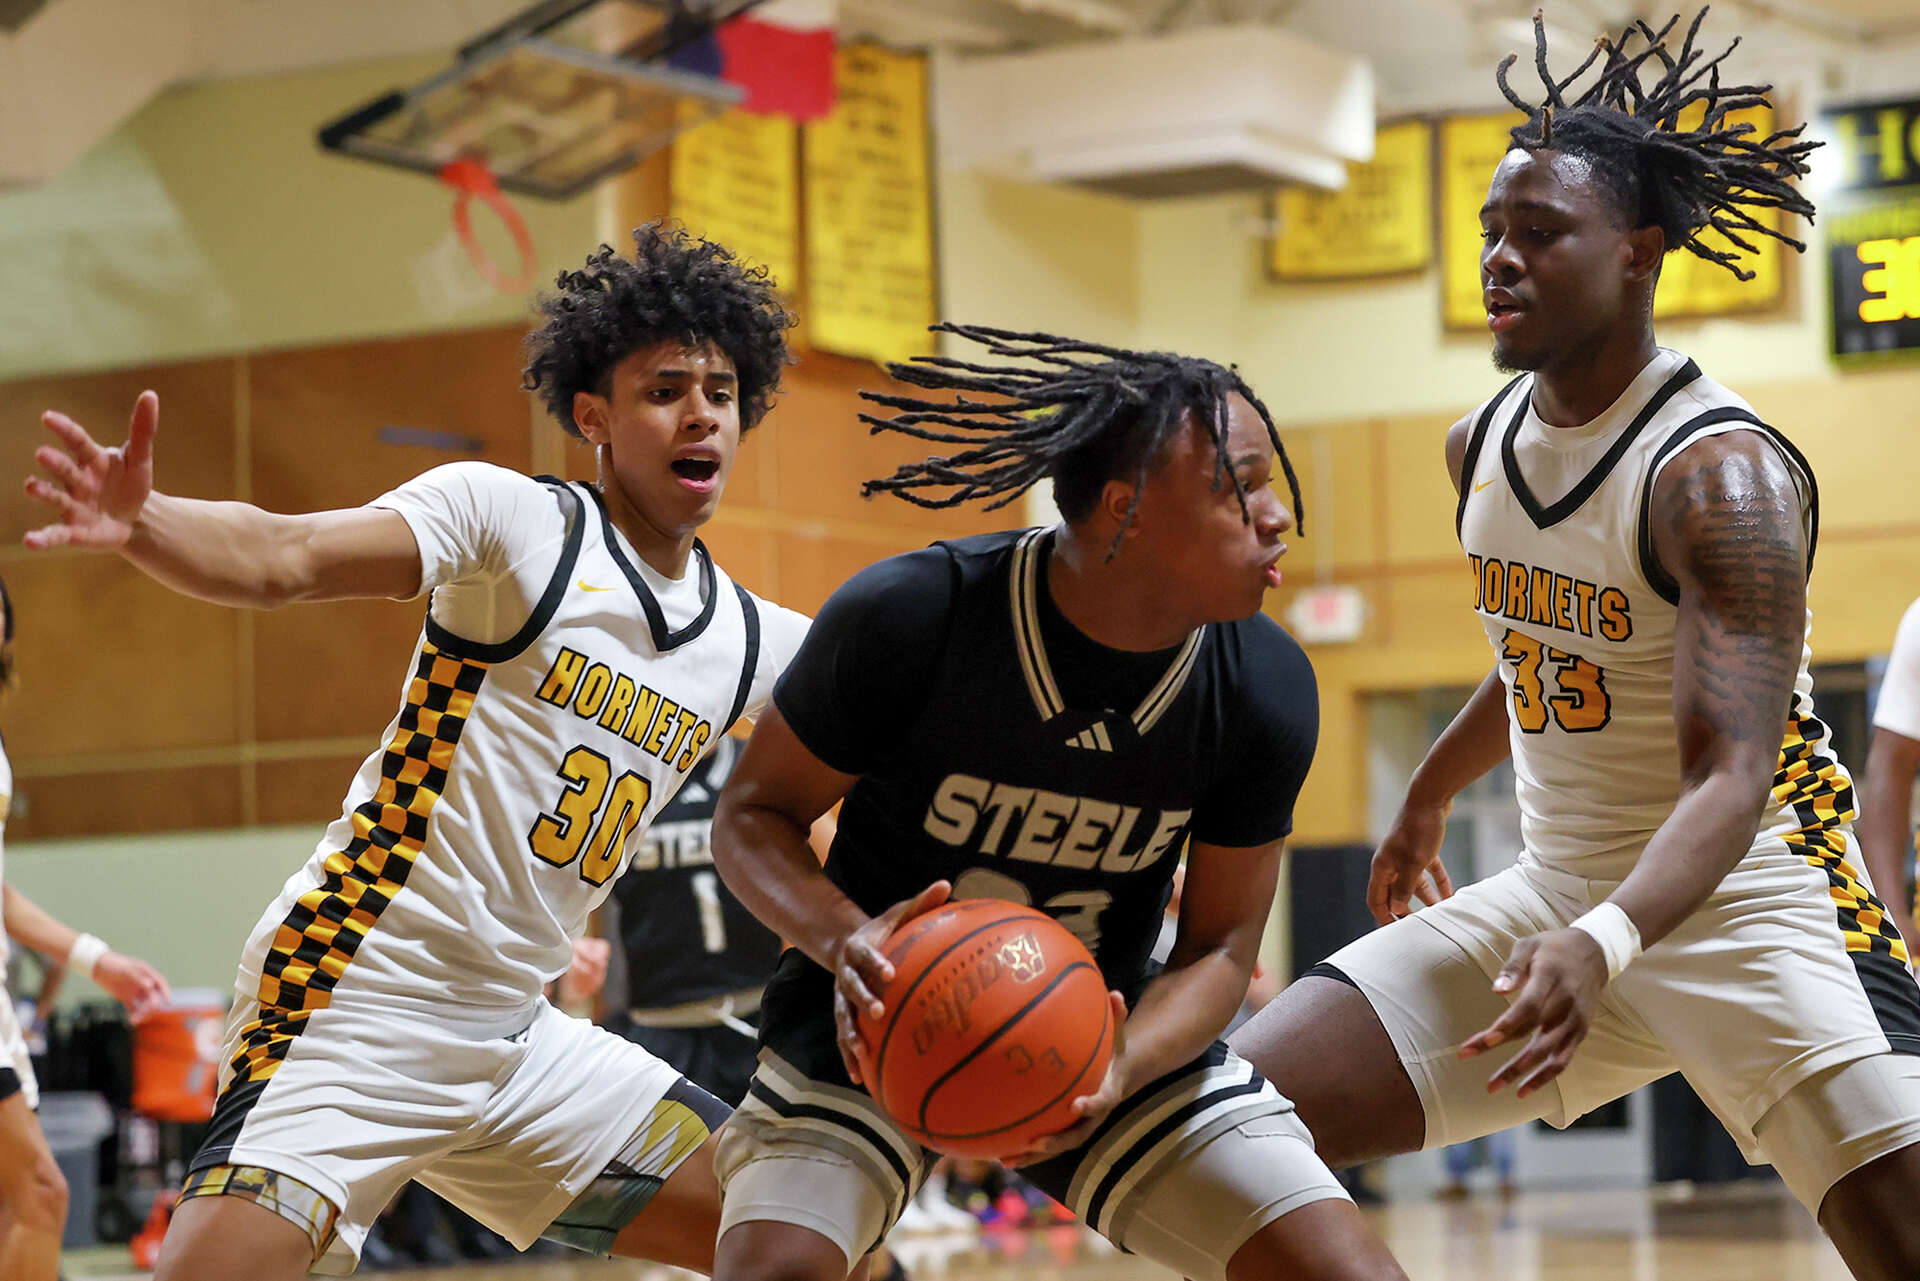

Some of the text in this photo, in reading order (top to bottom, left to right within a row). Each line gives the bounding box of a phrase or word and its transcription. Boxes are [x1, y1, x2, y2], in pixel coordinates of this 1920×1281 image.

[535, 646, 711, 773] HORNETS
[1501, 628, 1611, 734] 33
[528, 744, 651, 888] 30
[923, 773, 1193, 873] STEELE
[691, 871, 728, 953] 1
